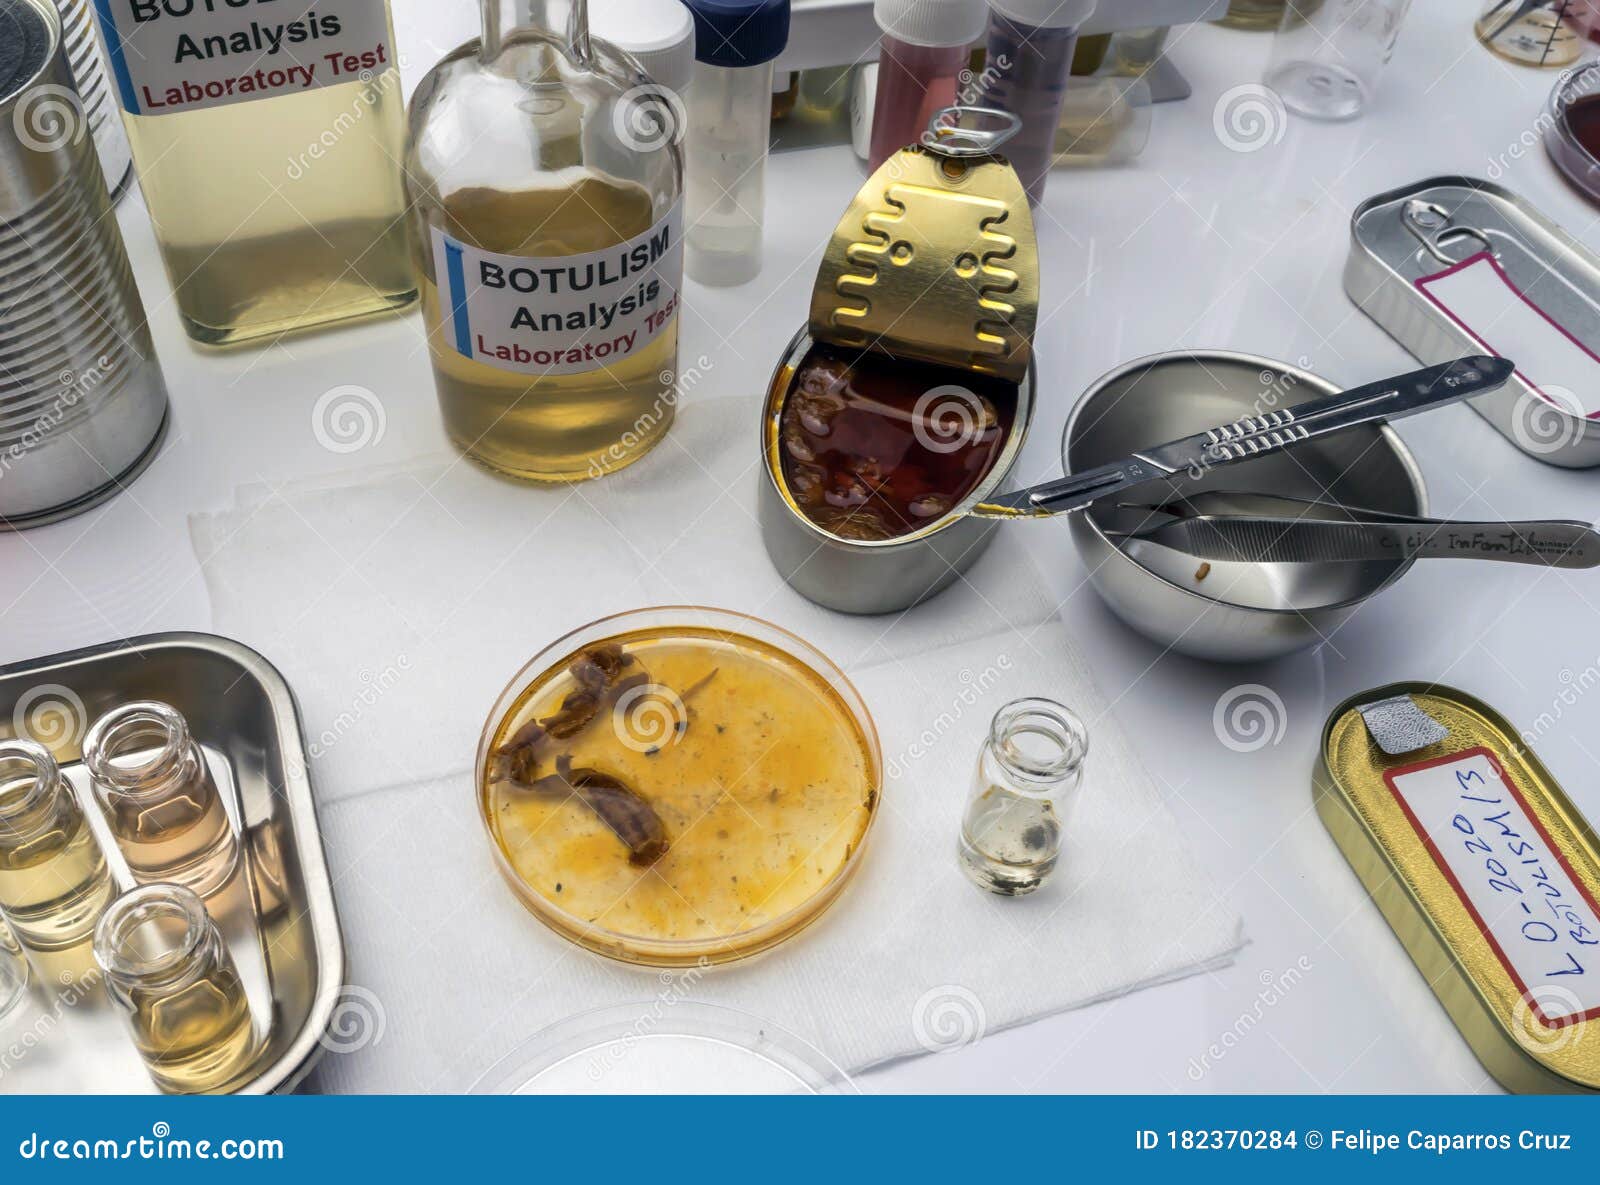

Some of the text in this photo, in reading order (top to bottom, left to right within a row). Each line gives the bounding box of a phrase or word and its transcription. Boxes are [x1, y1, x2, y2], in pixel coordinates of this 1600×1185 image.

[174, 12, 341, 63] Analysis
[142, 43, 387, 108] Laboratory Test
[480, 224, 669, 294] BOTULISM
[510, 279, 660, 331] Analysis
[477, 329, 637, 365] Laboratory
